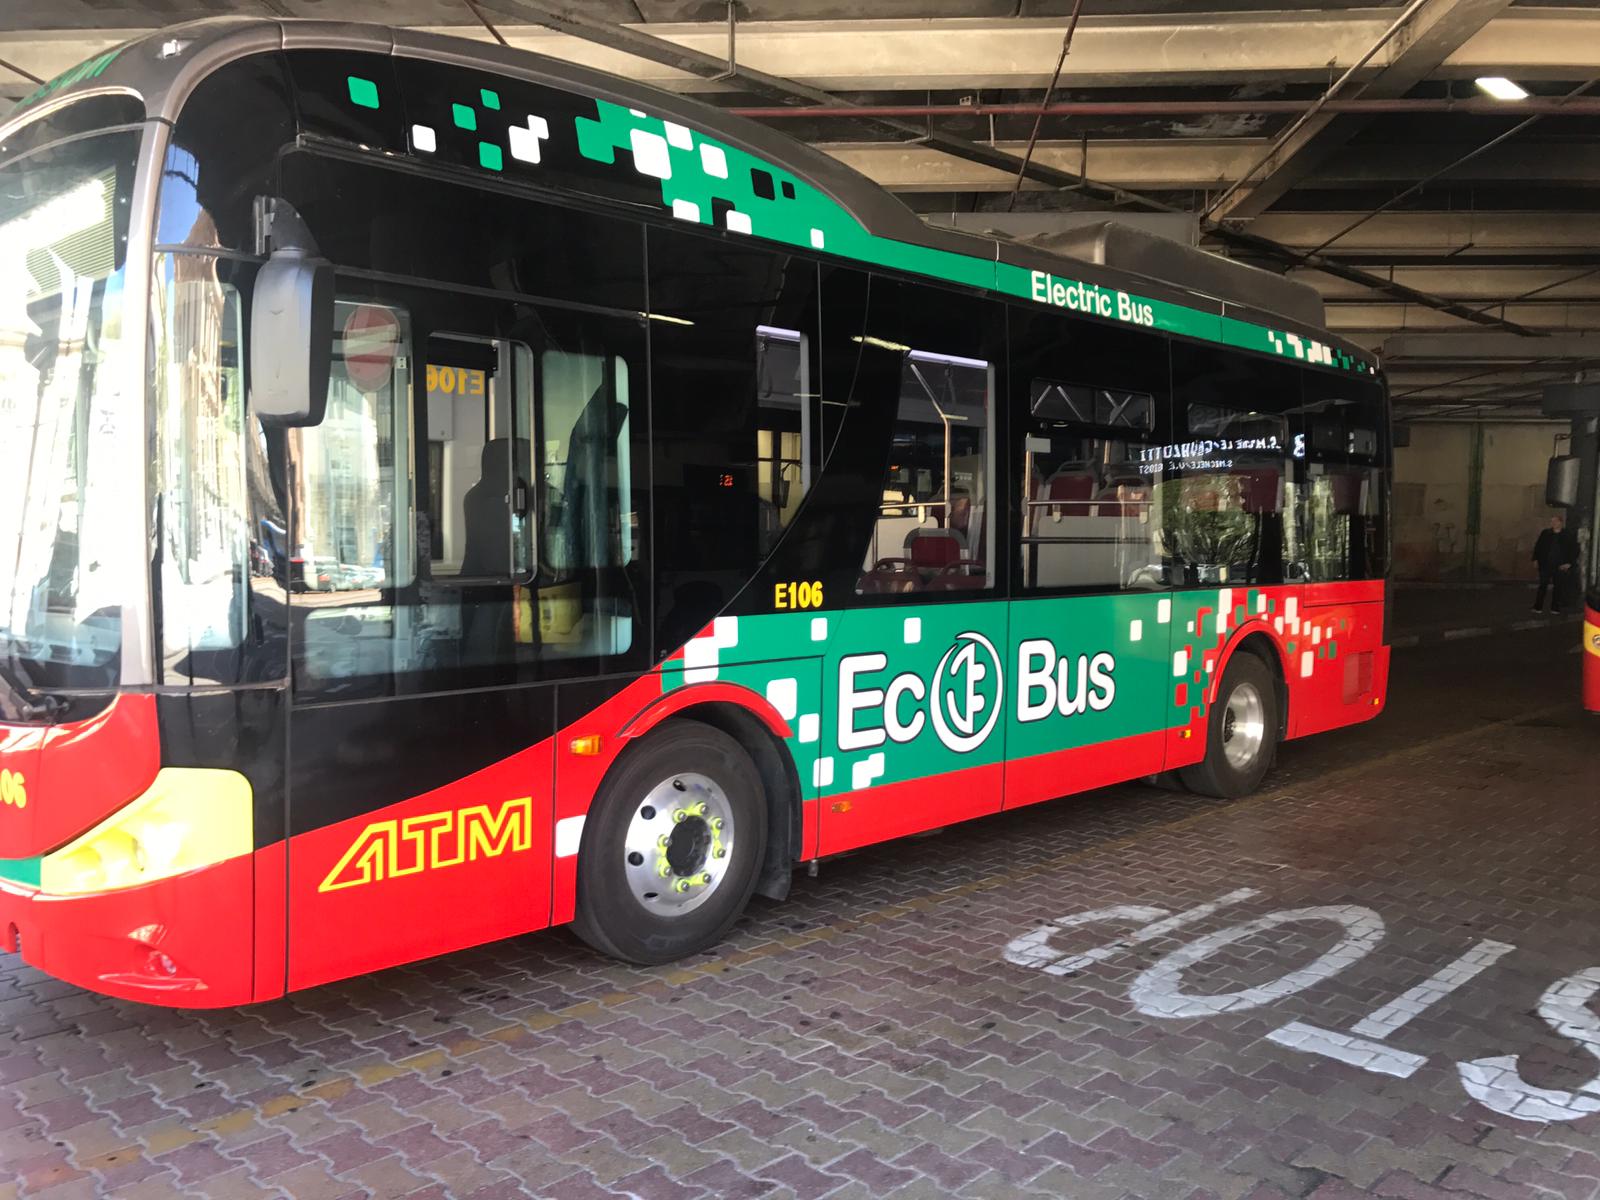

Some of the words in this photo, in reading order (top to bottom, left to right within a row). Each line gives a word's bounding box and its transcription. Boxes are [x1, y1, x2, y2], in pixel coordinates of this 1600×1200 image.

[1031, 270, 1112, 317] Electric
[1117, 291, 1154, 327] Bus
[775, 581, 823, 609] E106
[1017, 637, 1116, 724] Bus
[0, 768, 27, 809] 06
[318, 797, 532, 893] ATM
[1003, 886, 1600, 1122] STOP
